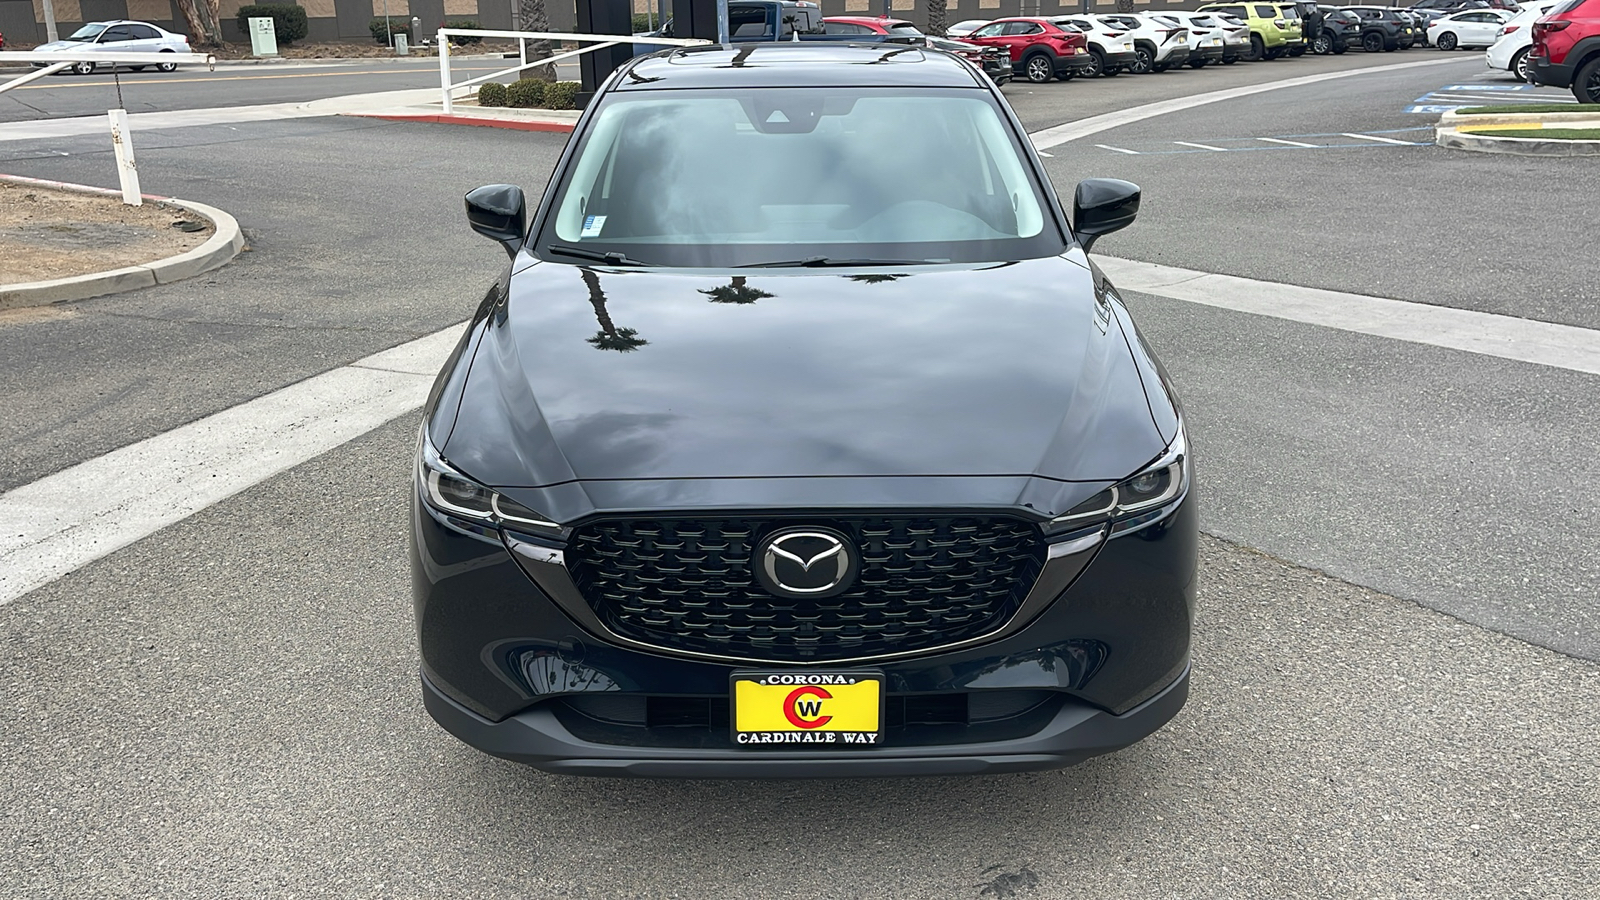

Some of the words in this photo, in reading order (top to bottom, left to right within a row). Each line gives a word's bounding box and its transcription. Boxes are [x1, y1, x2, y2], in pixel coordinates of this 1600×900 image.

[767, 675, 847, 685] CORONA
[737, 732, 836, 743] CARDINALE
[843, 732, 879, 743] WAY
